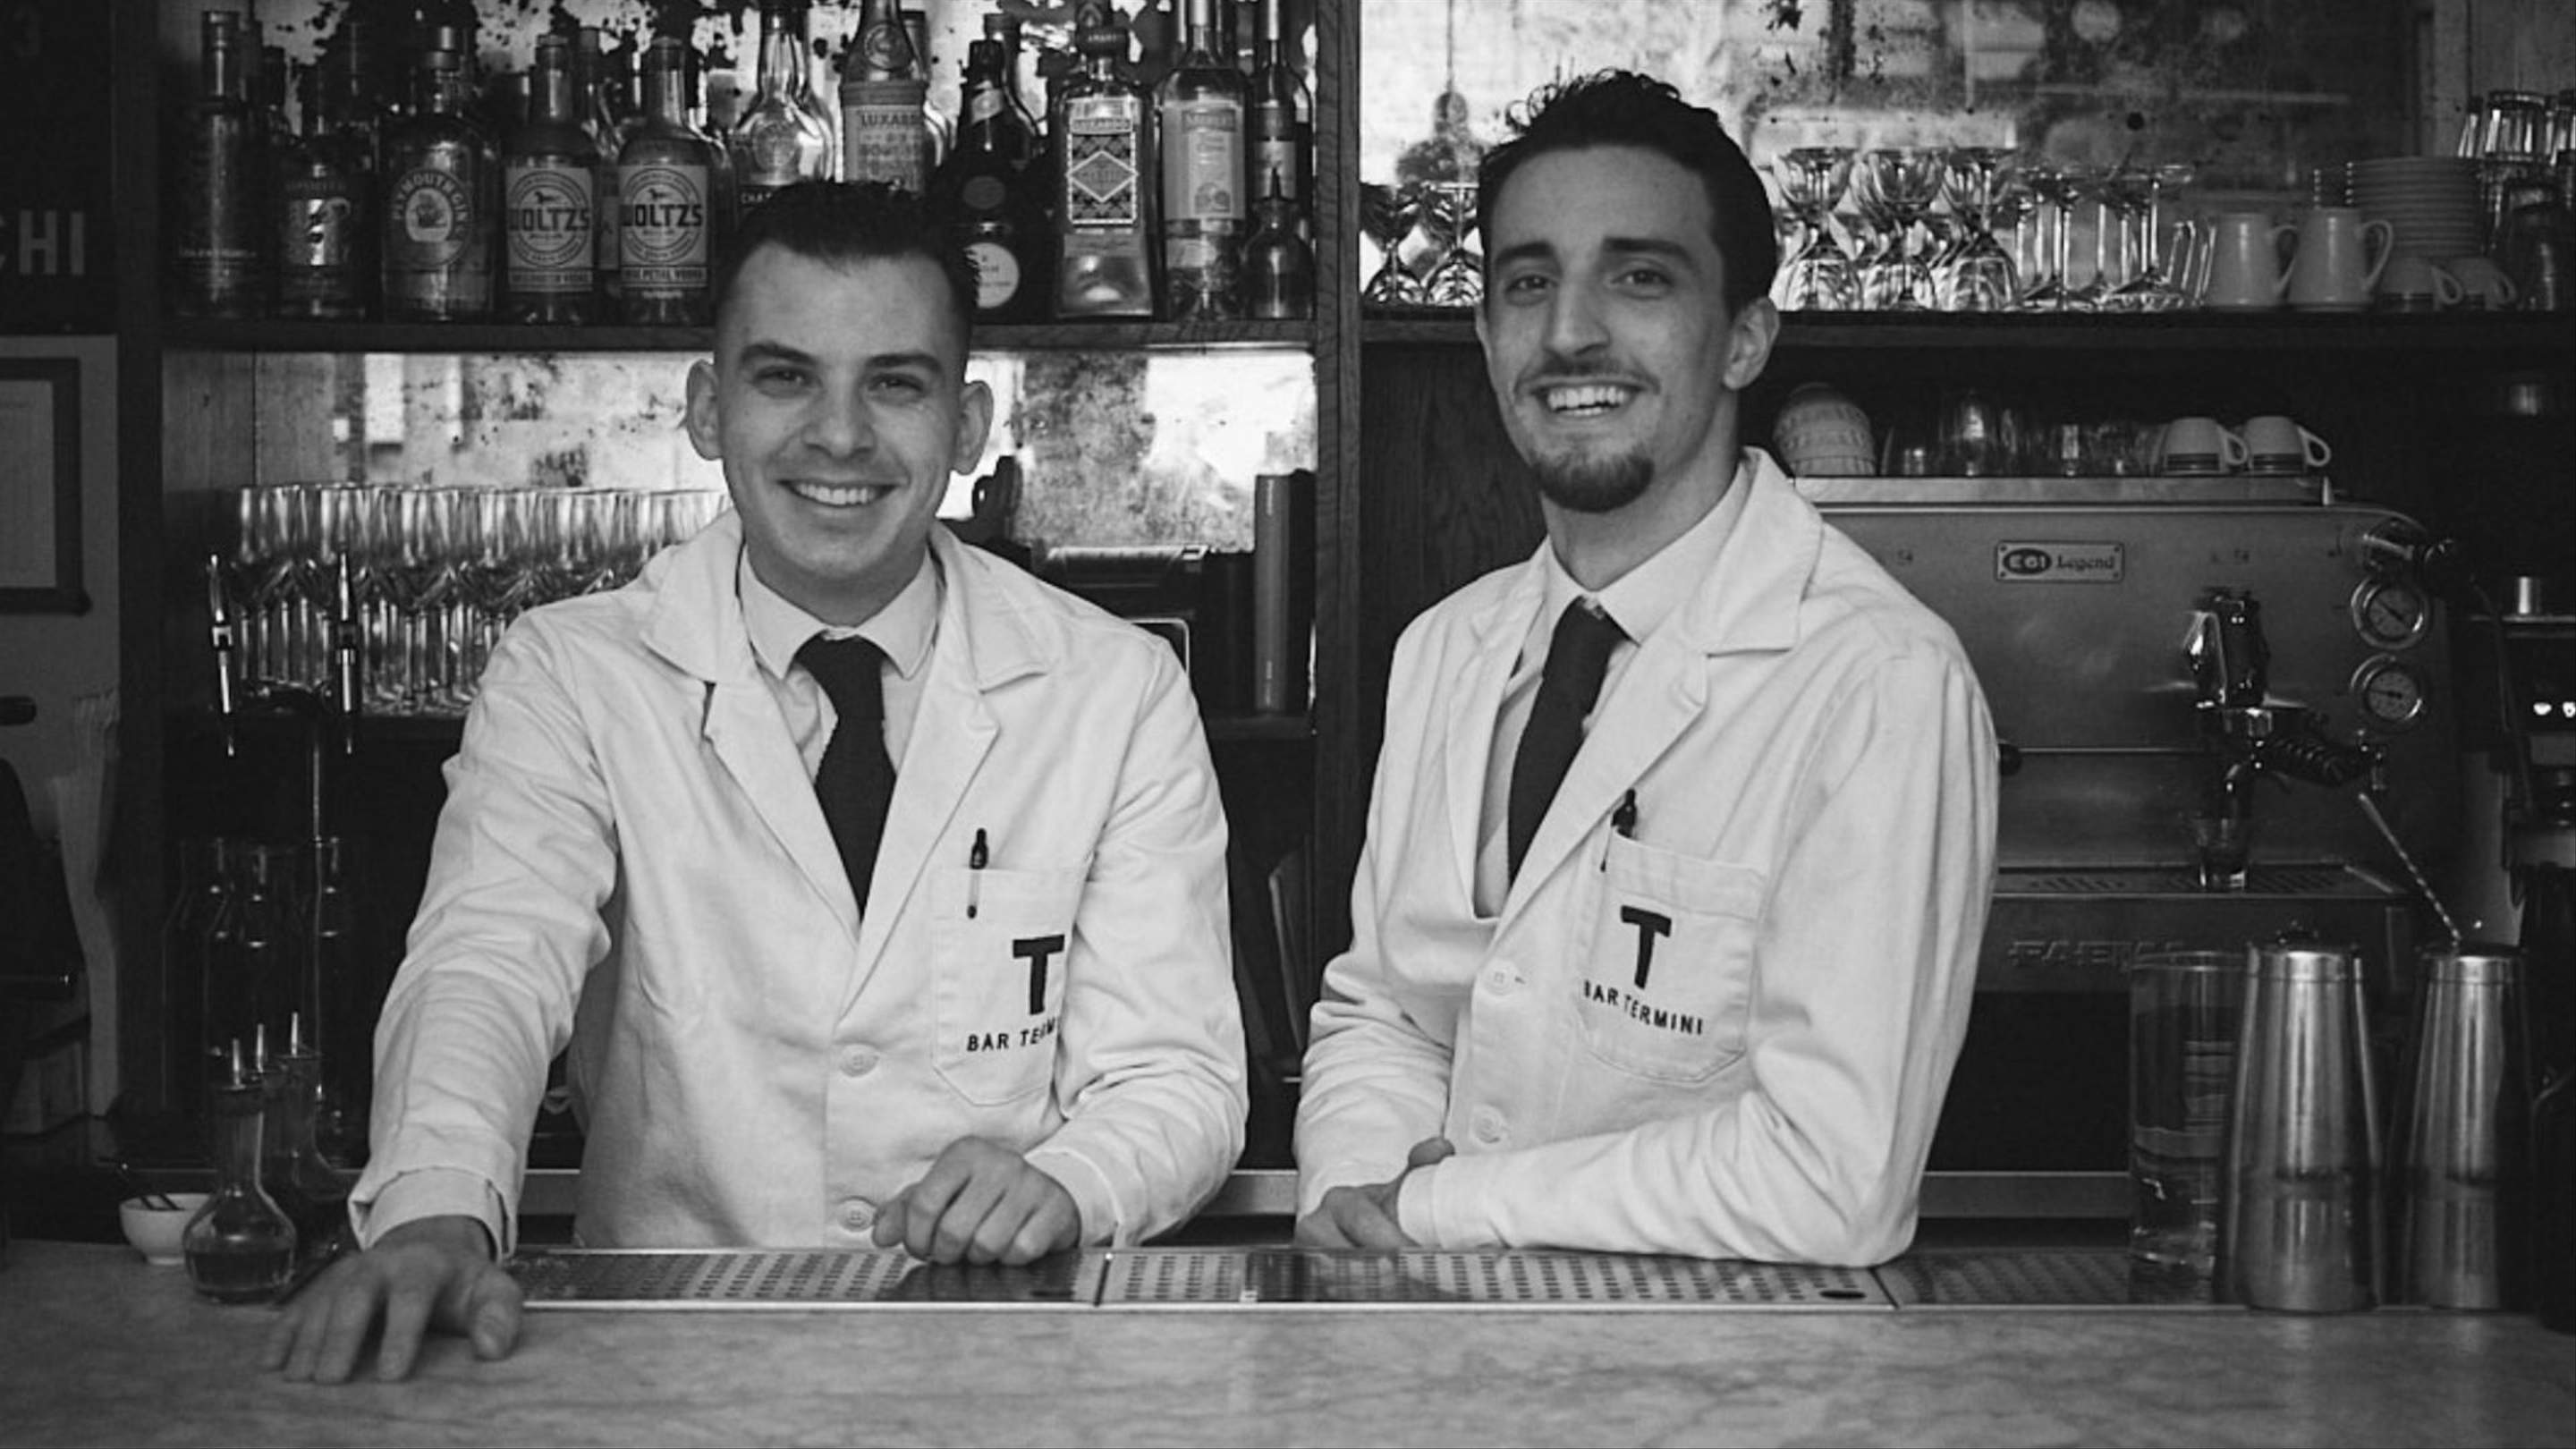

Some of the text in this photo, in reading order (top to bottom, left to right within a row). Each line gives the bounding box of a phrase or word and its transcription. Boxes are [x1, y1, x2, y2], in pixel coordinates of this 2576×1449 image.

[0, 210, 84, 276] HI
[2057, 555, 2115, 571] Legend
[1619, 904, 1673, 991] T
[1013, 934, 1065, 1016] T
[966, 1032, 1010, 1053] BAR
[1623, 994, 1704, 1037] TERMINI
